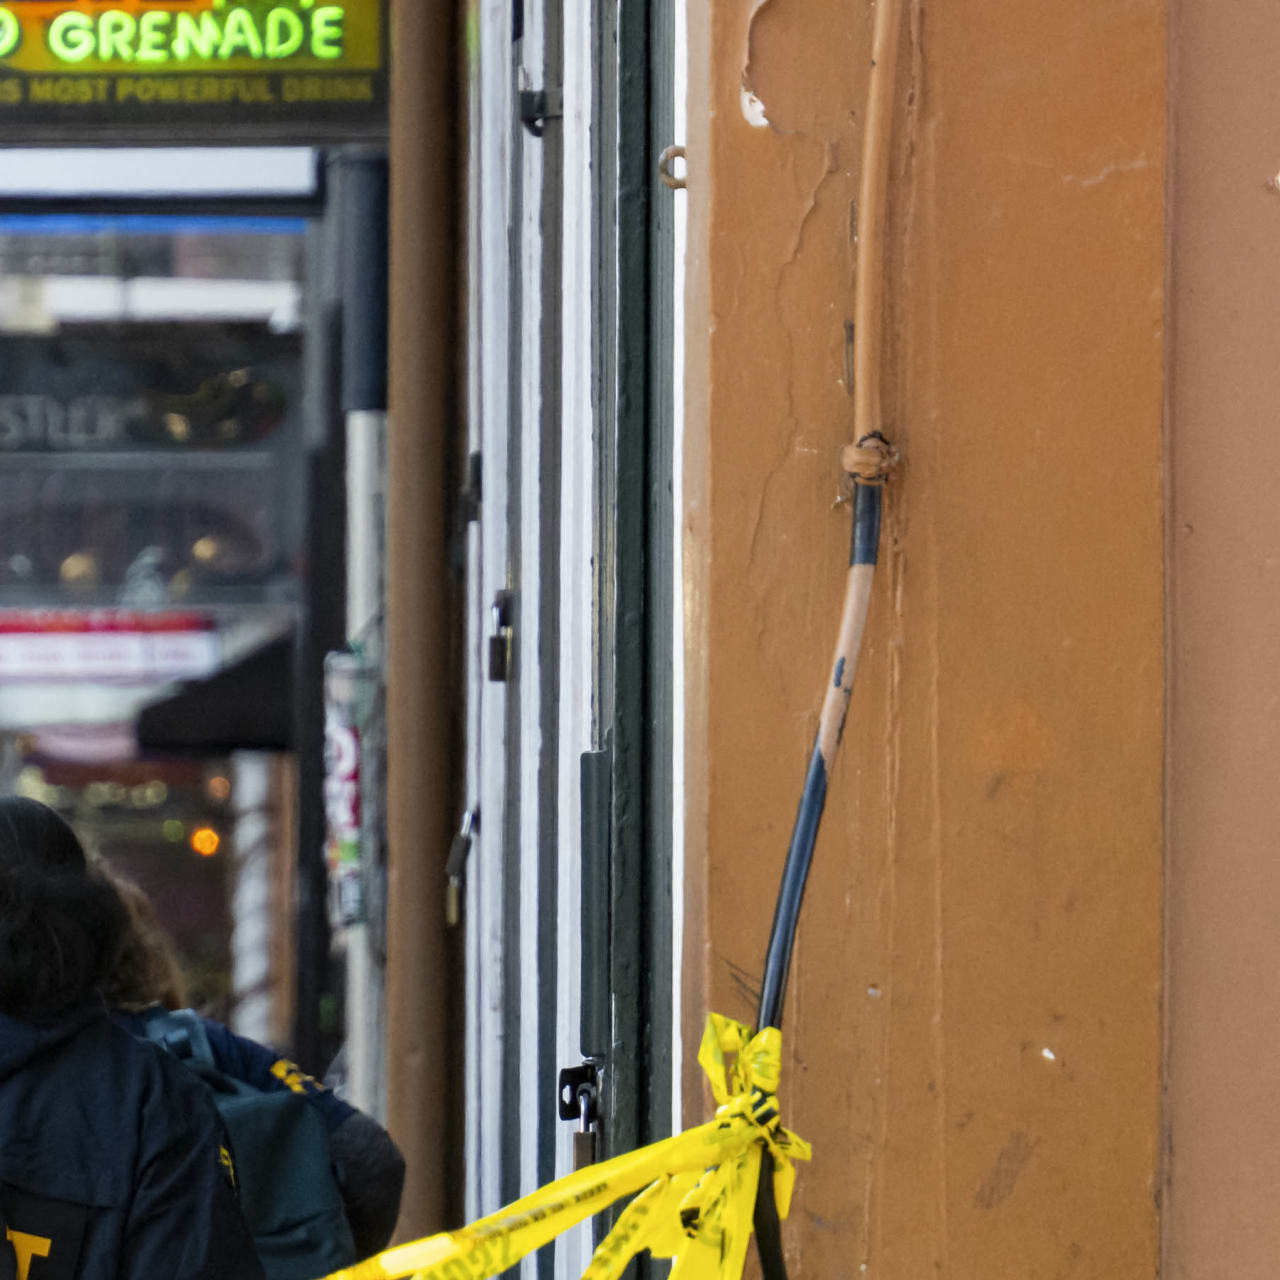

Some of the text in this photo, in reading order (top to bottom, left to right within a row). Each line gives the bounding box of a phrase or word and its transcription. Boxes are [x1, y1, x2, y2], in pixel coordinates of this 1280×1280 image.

[48, 6, 345, 62] GRENADE
[29, 77, 109, 103] MOST
[116, 77, 274, 103] POWERFUL
[280, 77, 374, 102] DRINK
